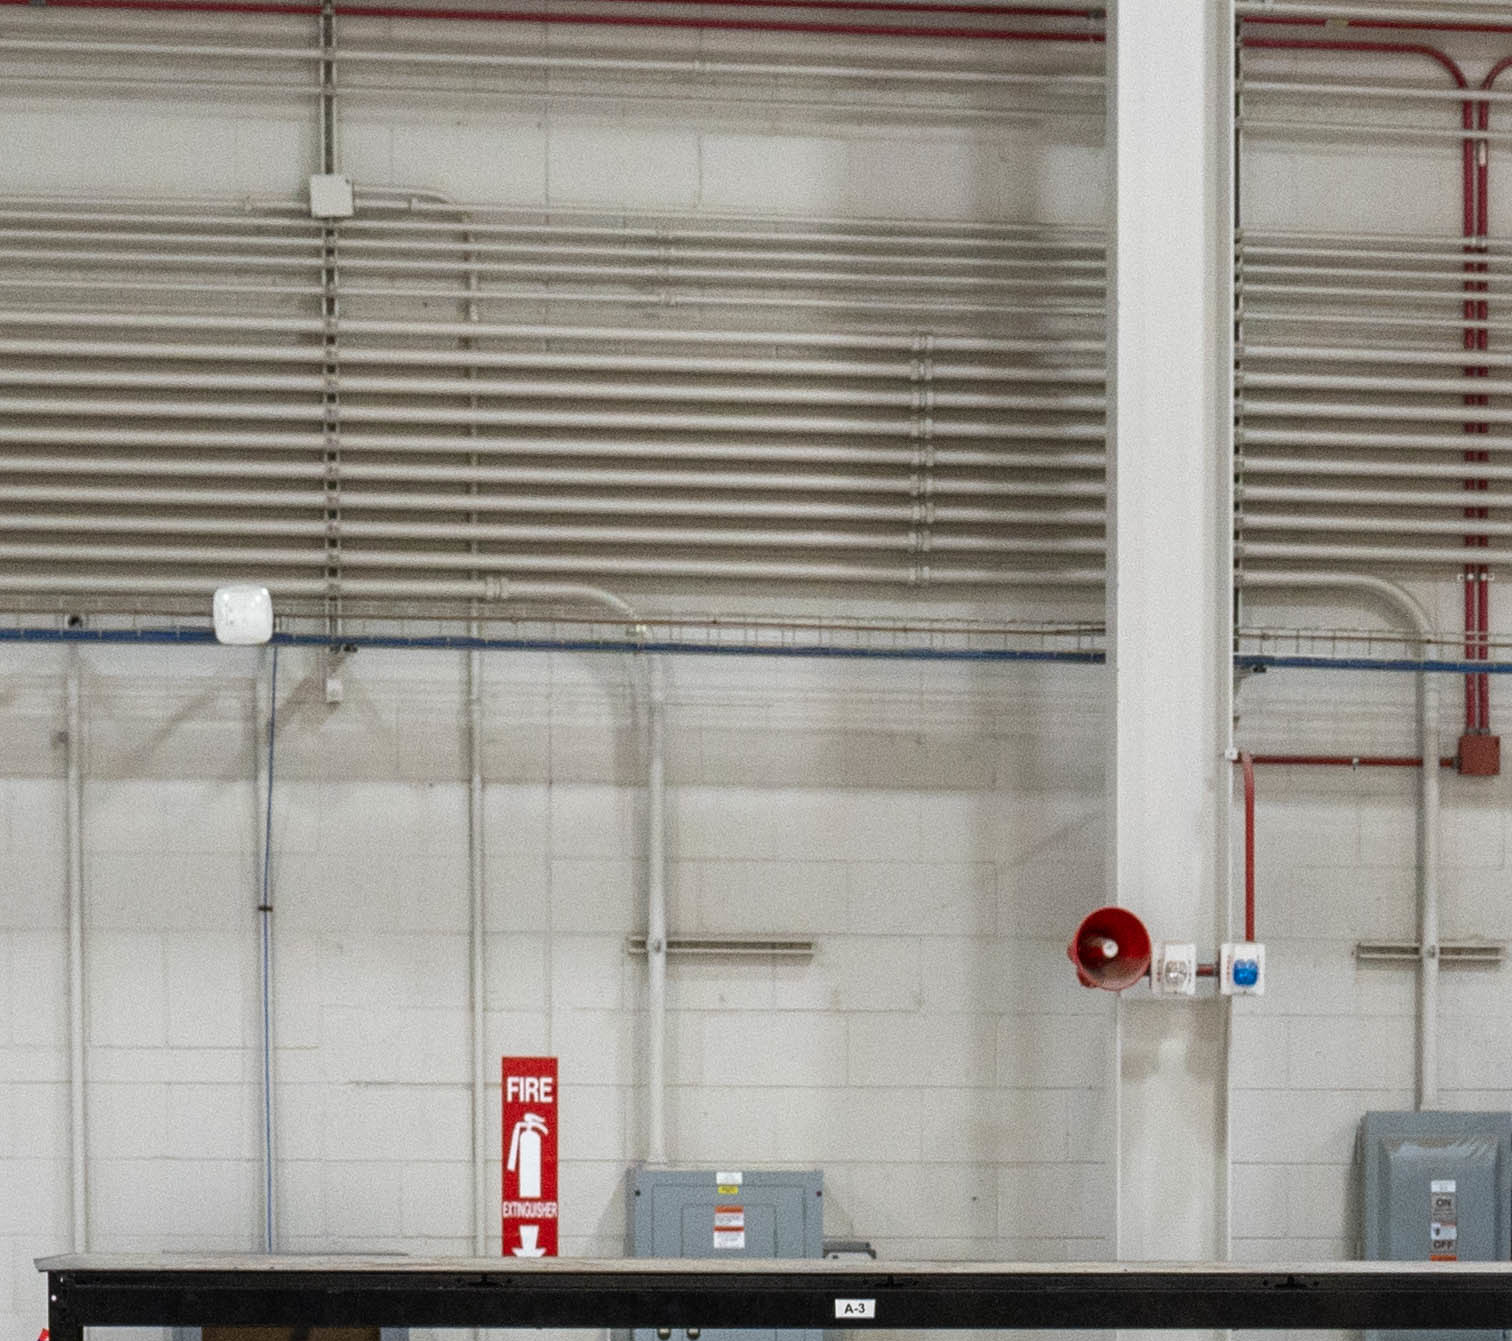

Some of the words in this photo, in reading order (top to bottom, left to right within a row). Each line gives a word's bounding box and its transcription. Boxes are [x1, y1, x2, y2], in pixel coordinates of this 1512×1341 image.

[506, 1076, 553, 1103] FIRE
[503, 1201, 558, 1218] EXTINGUISHER
[844, 1303, 865, 1314] A-3
